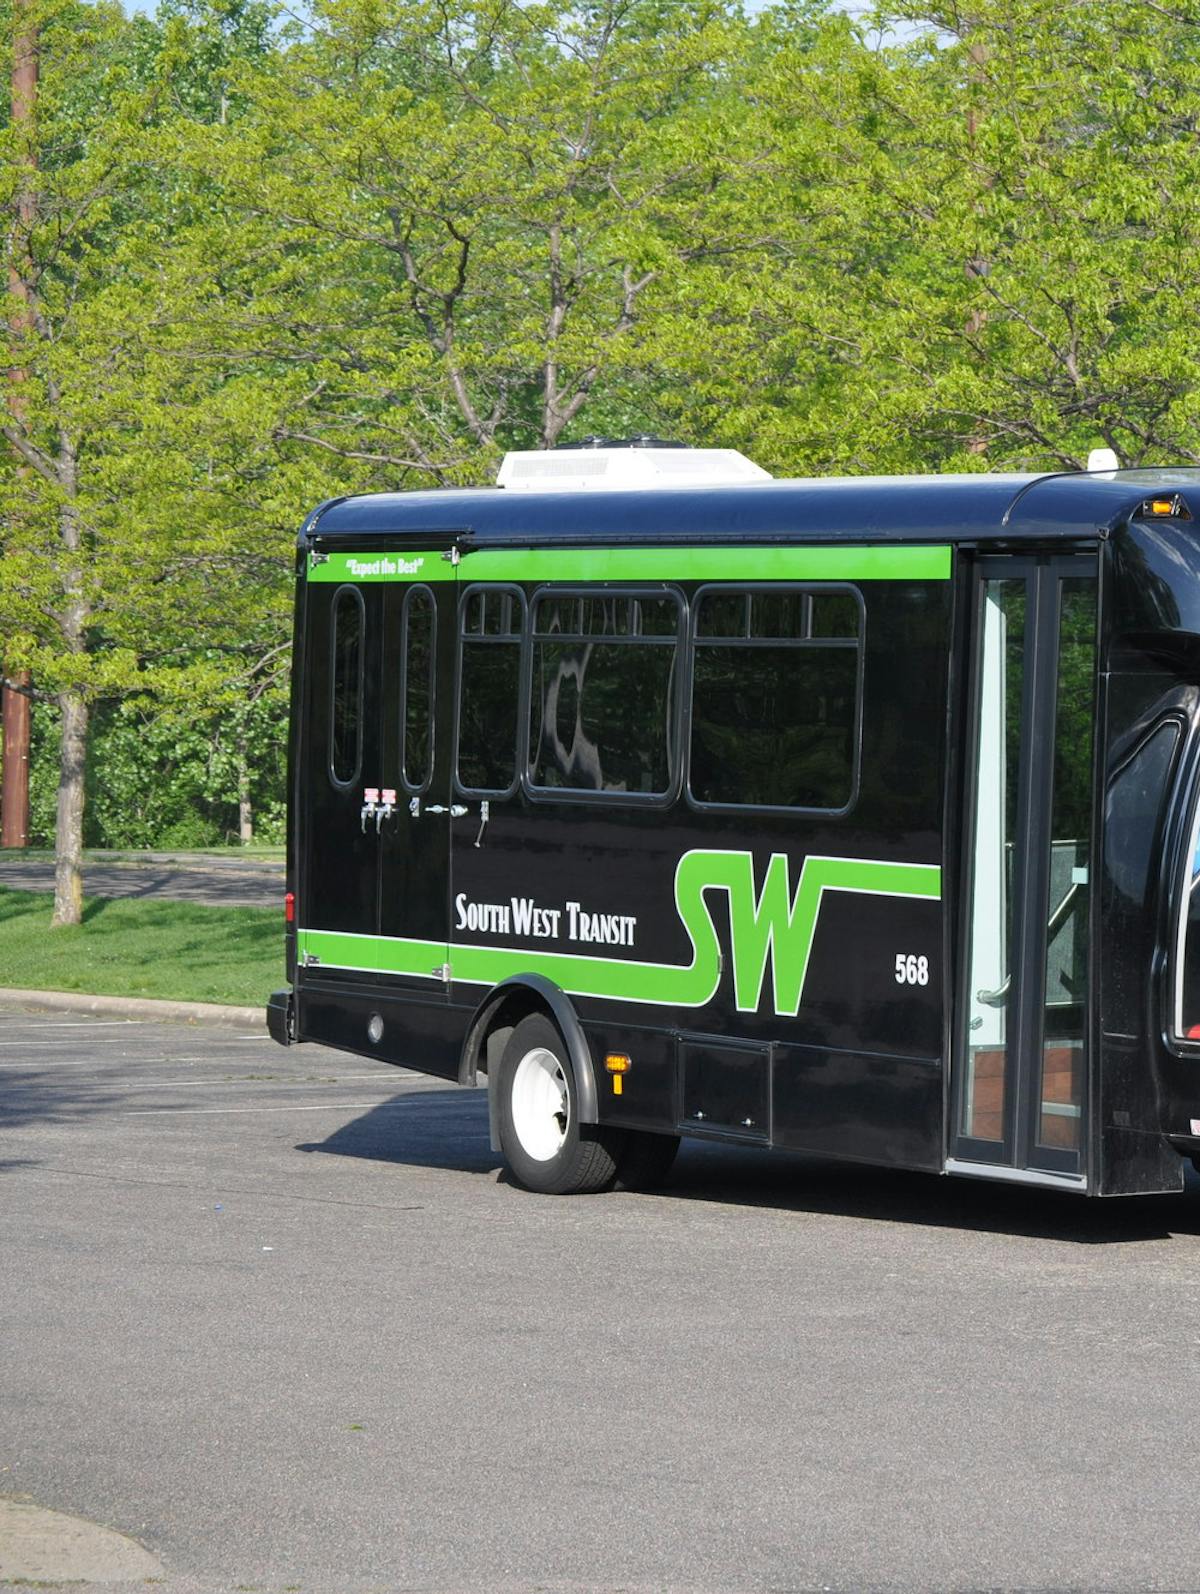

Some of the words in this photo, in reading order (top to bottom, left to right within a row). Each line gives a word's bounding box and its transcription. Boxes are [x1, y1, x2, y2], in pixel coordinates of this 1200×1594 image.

[381, 557, 396, 575] the
[565, 902, 637, 946] TRANSIT
[674, 849, 824, 1017] SW
[894, 953, 929, 986] 568
